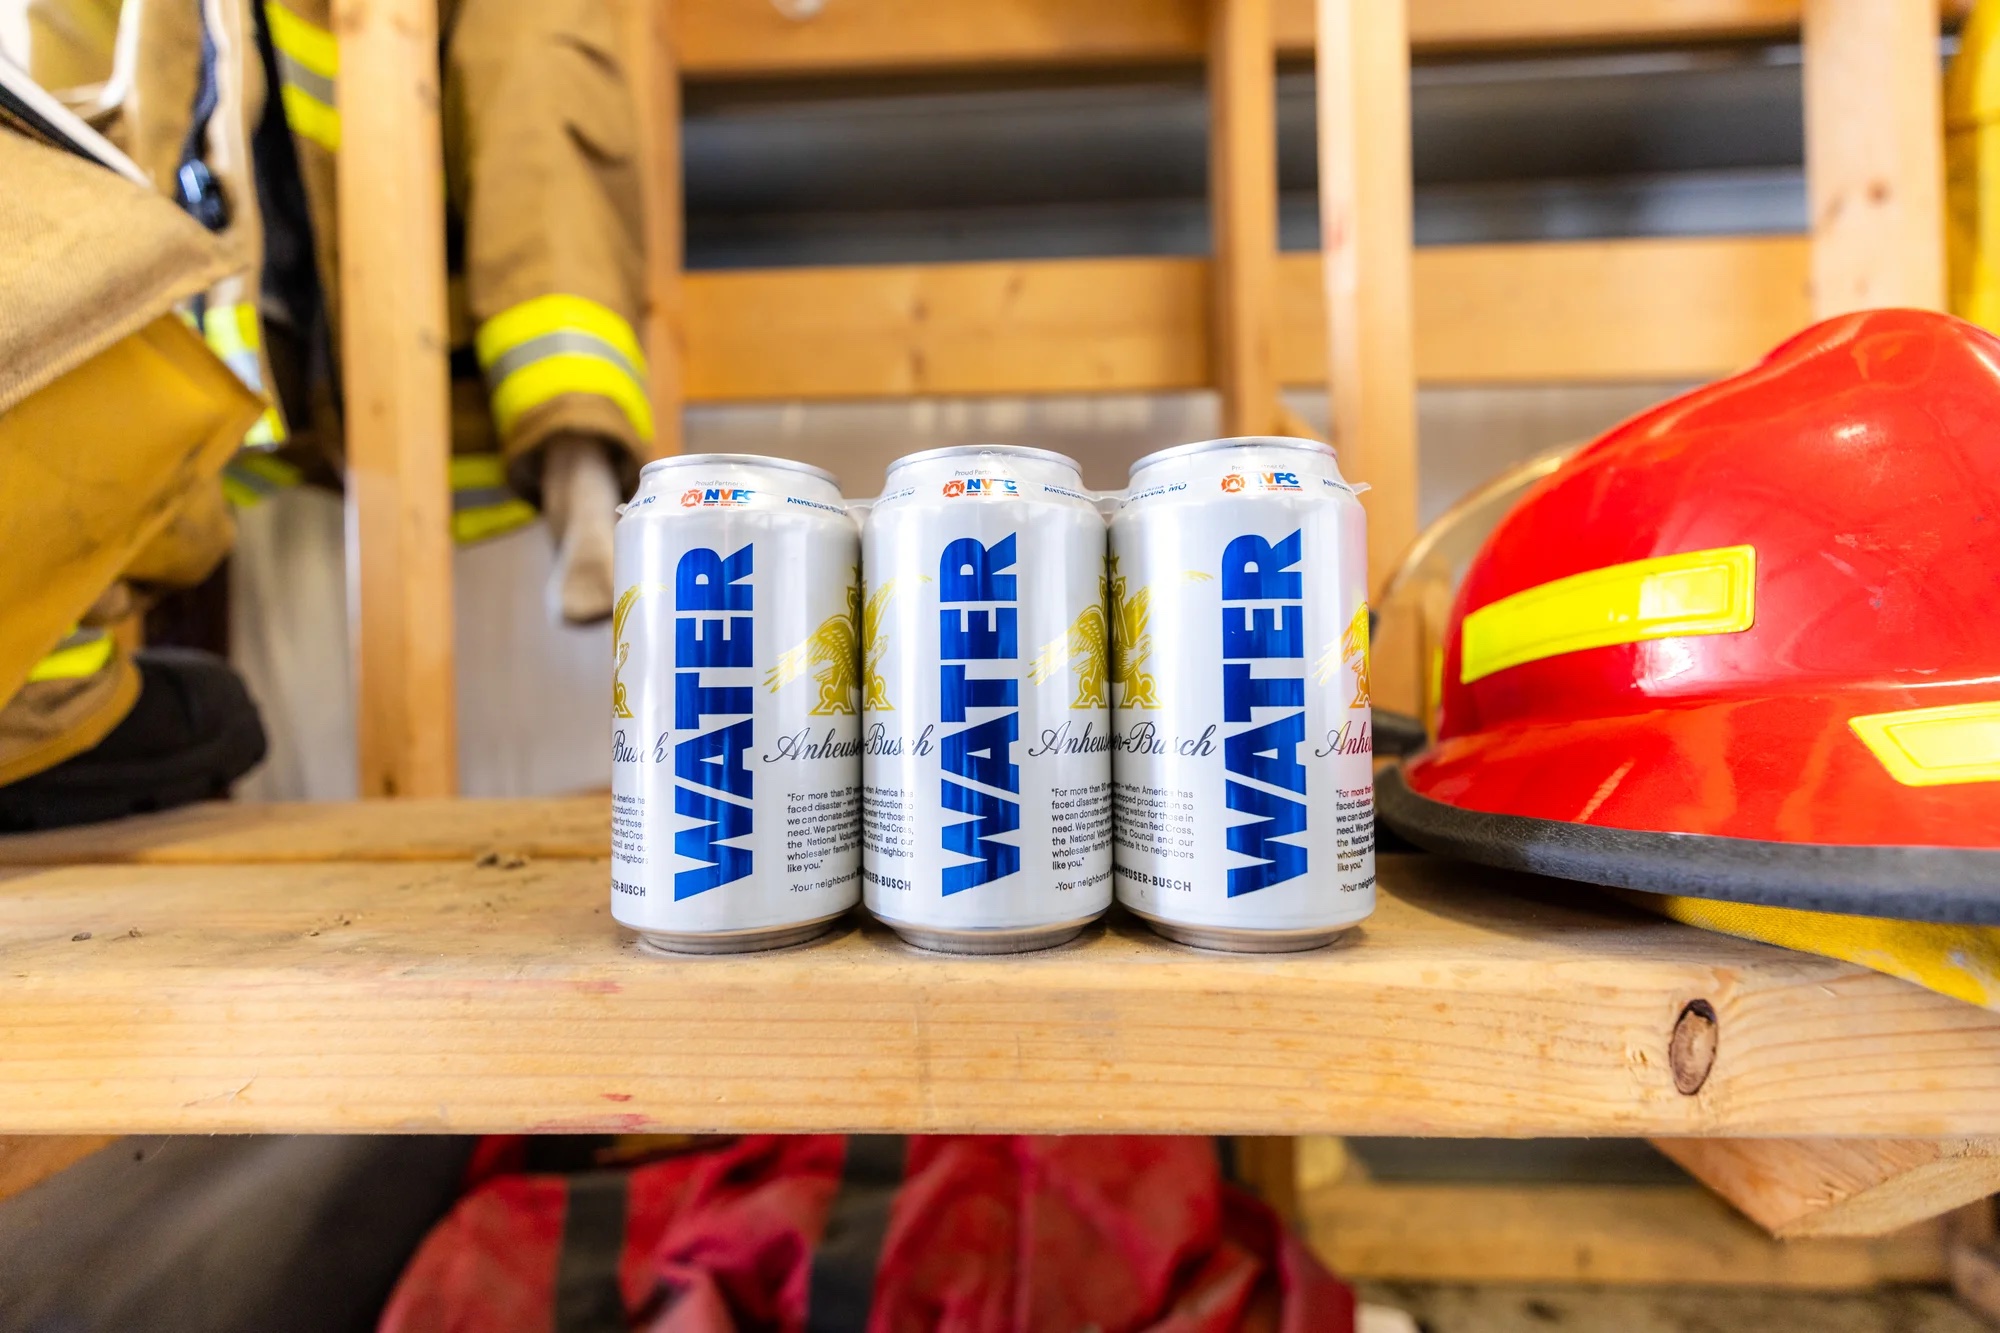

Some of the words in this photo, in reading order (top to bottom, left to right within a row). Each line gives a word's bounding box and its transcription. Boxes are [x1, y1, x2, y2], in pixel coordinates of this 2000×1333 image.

[966, 479, 1017, 491] NVC
[704, 489, 756, 501] NVFC
[939, 532, 1020, 897] WATER
[1221, 528, 1308, 898] WATER
[674, 542, 754, 902] WATER
[808, 792, 828, 800] more
[830, 788, 844, 798] than
[846, 787, 852, 796] 30
[875, 787, 898, 798] America
[1070, 787, 1088, 796] more
[1089, 784, 1101, 794] than
[1125, 783, 1140, 793] when
[1177, 789, 1194, 799] has
[1351, 788, 1364, 797] more
[787, 803, 813, 814] faced
[815, 800, 842, 811] disaster
[1051, 799, 1075, 810] faced
[1076, 796, 1099, 808] disaster
[1137, 797, 1180, 810] production
[1182, 803, 1194, 811] so
[1336, 801, 1355, 811] faced
[802, 816, 817, 824] can
[818, 812, 842, 823] donate
[887, 812, 906, 822] those
[1065, 812, 1079, 820] can
[1079, 807, 1099, 819] donate
[1130, 807, 1146, 818] water
[1147, 809, 1158, 819] for
[1159, 811, 1184, 822] those
[1185, 813, 1194, 823] in
[1347, 813, 1358, 821] can
[787, 827, 812, 837] need.
[813, 825, 825, 834] We
[826, 821, 849, 834] partner
[880, 821, 891, 832] Red
[1051, 823, 1074, 834] need.
[1076, 822, 1086, 831] We
[1149, 821, 1164, 832] Red
[1165, 823, 1194, 836] Cross,
[1336, 823, 1355, 835] need.
[1355, 823, 1363, 832] We
[787, 841, 803, 850] the
[807, 835, 837, 847] National
[885, 836, 898, 845] and
[900, 838, 914, 846] our
[1051, 836, 1066, 846] the
[1069, 831, 1096, 844] National
[1129, 828, 1154, 842] Council
[1157, 834, 1174, 845] and
[1178, 838, 1194, 847] our
[1337, 839, 1349, 847] the
[1351, 834, 1369, 845] National
[787, 847, 831, 861] wholesaler
[880, 846, 914, 858] neighbors
[1051, 845, 1091, 859] wholesaler
[1135, 841, 1140, 850] it
[1141, 843, 1149, 853] to
[1150, 846, 1194, 860] neighbors
[1337, 847, 1367, 860] wholesaler
[787, 863, 802, 873] like
[1052, 860, 1066, 870] like
[1337, 863, 1349, 872] like
[815, 875, 850, 889] neighbors
[1077, 872, 1106, 887] neighbors
